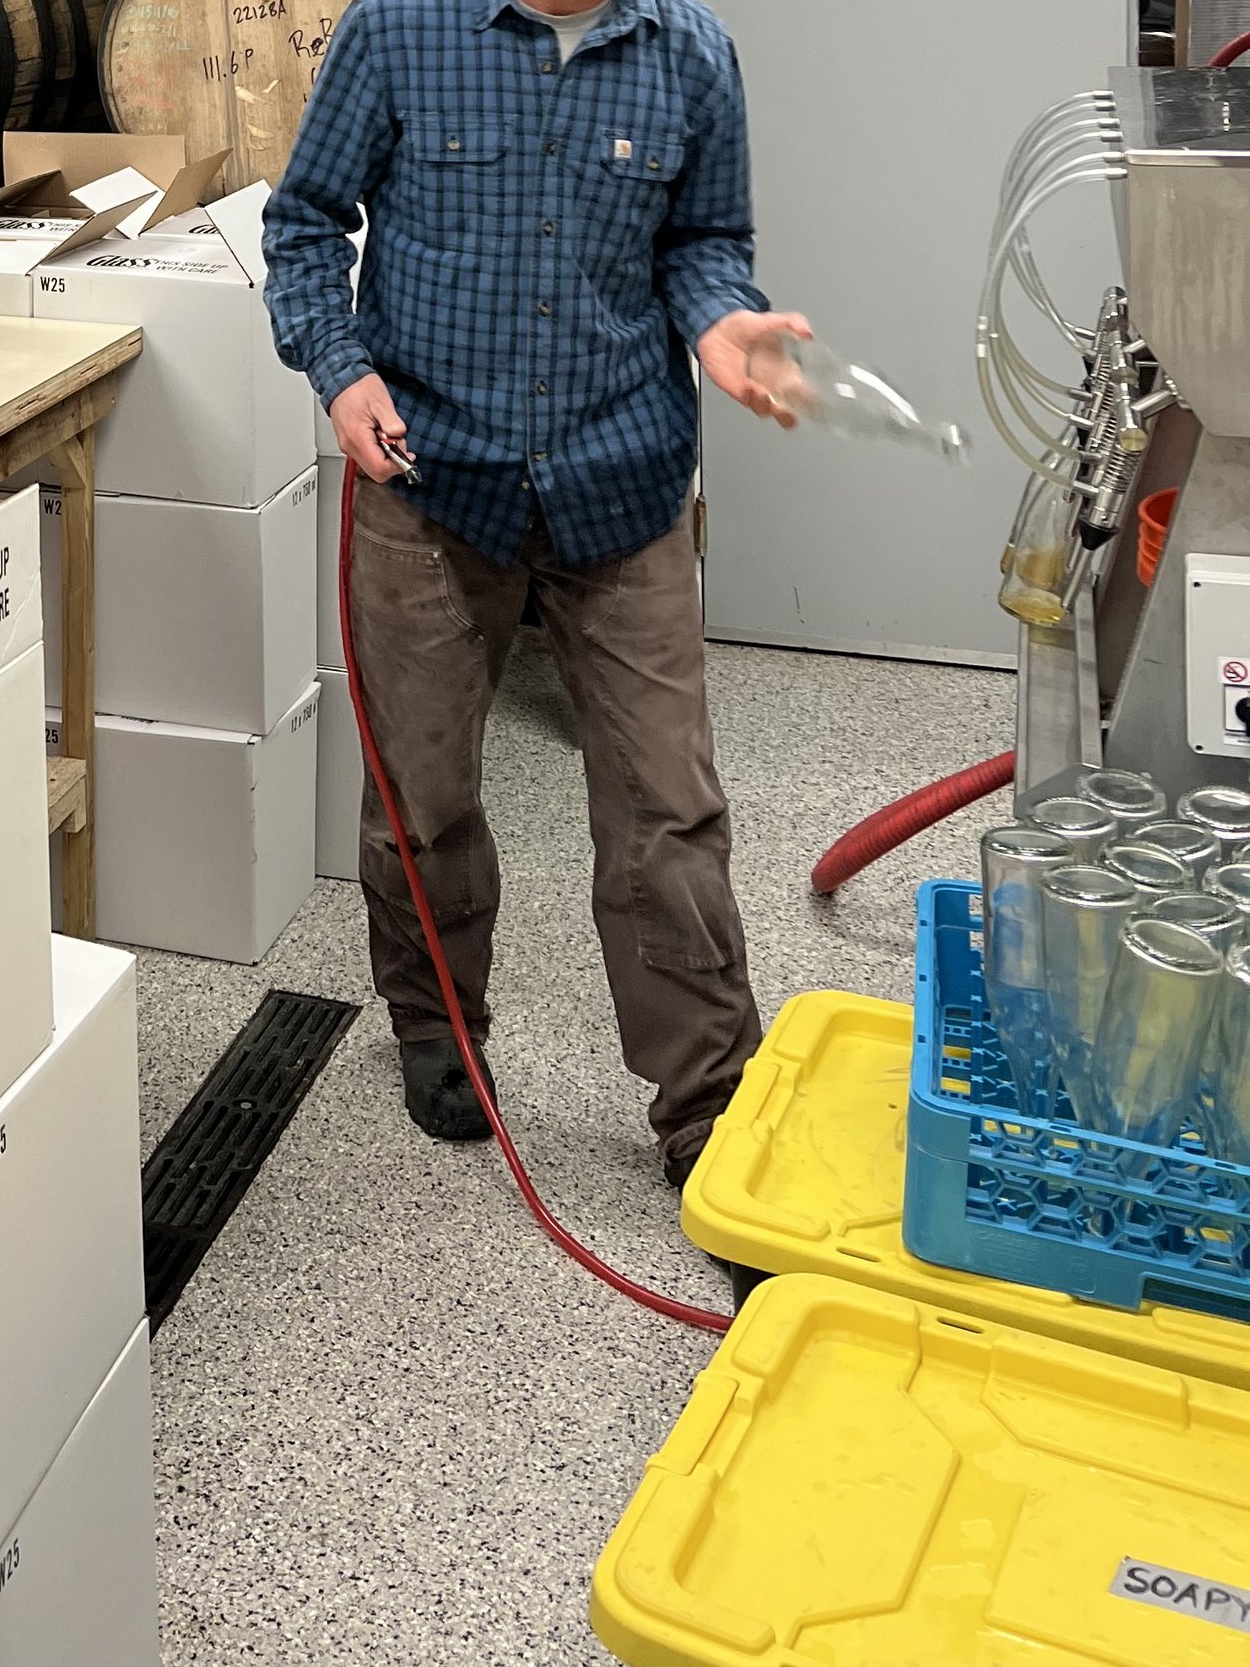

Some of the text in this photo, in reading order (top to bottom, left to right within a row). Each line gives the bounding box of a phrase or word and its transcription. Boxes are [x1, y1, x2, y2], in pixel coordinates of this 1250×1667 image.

[86, 255, 154, 268] Glass
[40, 276, 66, 293] W25
[44, 499, 62, 515] W2
[45, 729, 59, 744] 25
[1123, 1566, 1250, 1622] SOAPY
